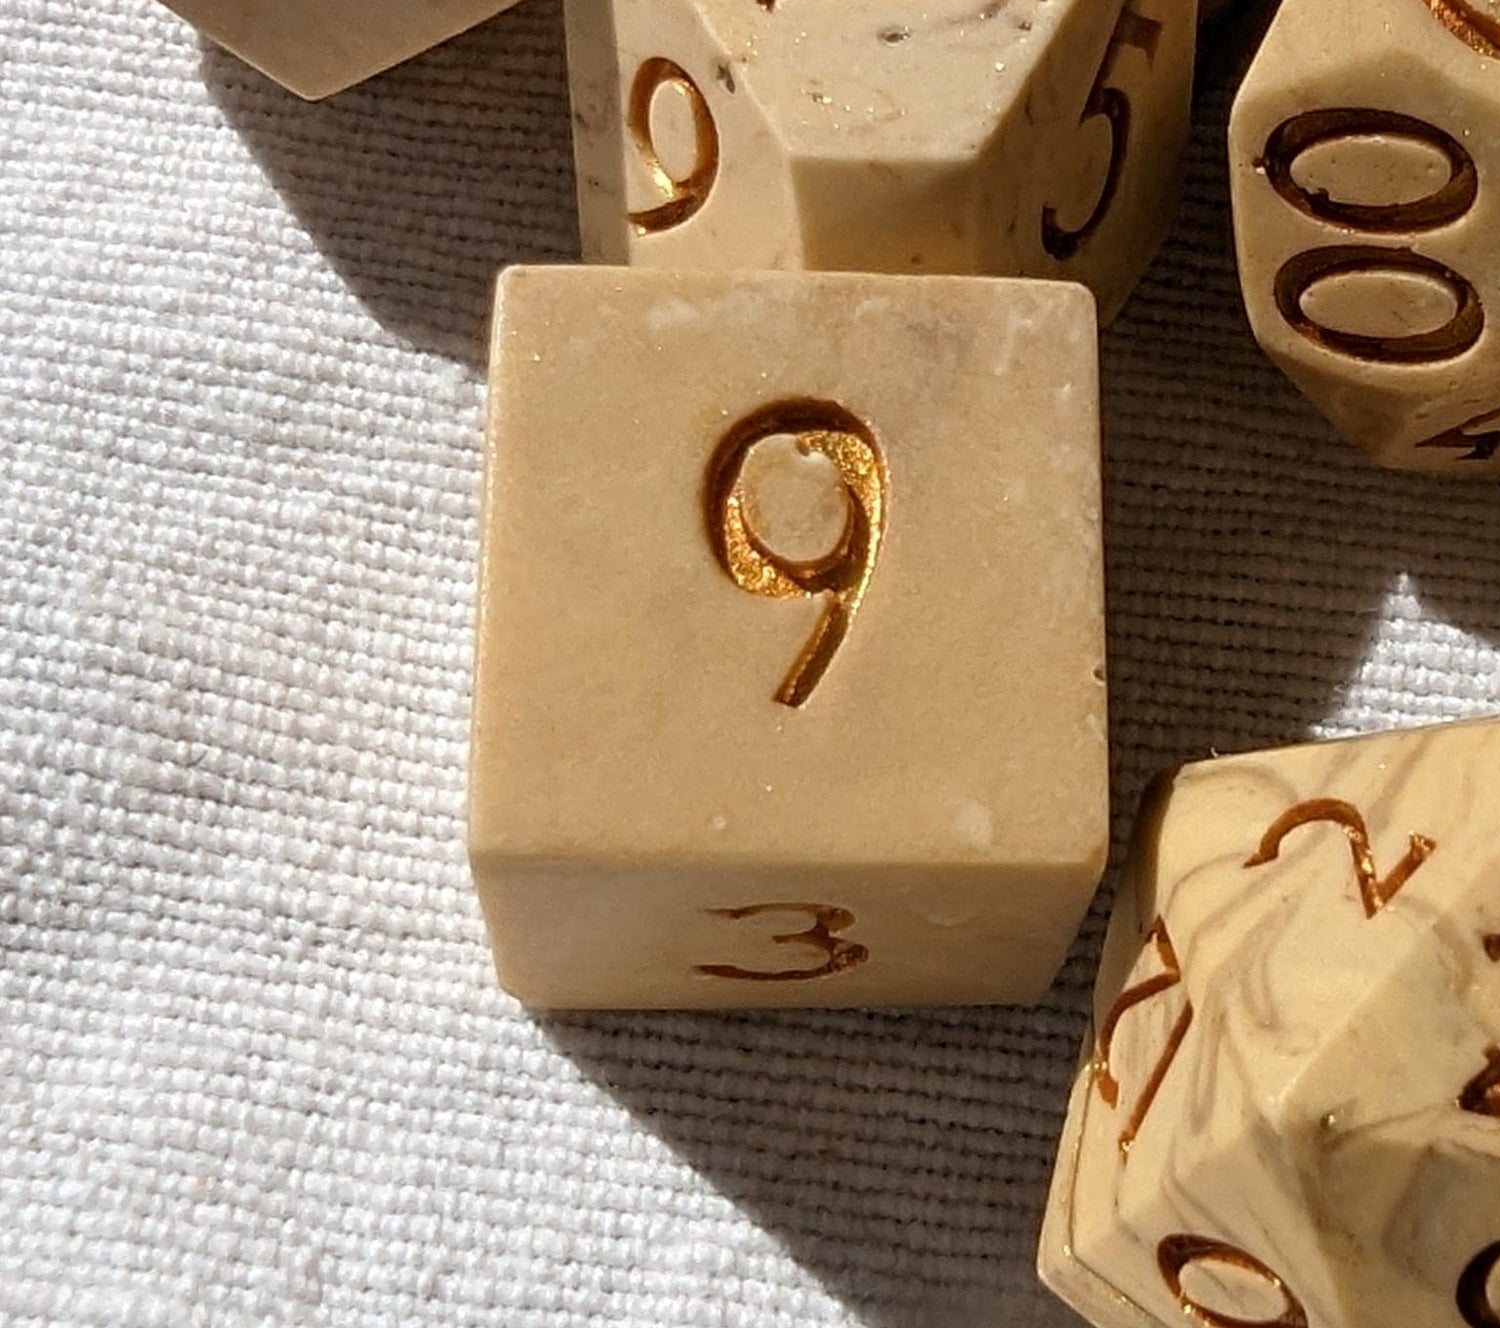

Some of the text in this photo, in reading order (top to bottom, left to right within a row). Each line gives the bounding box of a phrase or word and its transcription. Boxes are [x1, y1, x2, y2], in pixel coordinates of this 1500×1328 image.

[1040, 4, 1163, 261] 5
[1262, 107, 1486, 364] 00
[692, 901, 871, 982] 3
[1242, 797, 1437, 920] 2
